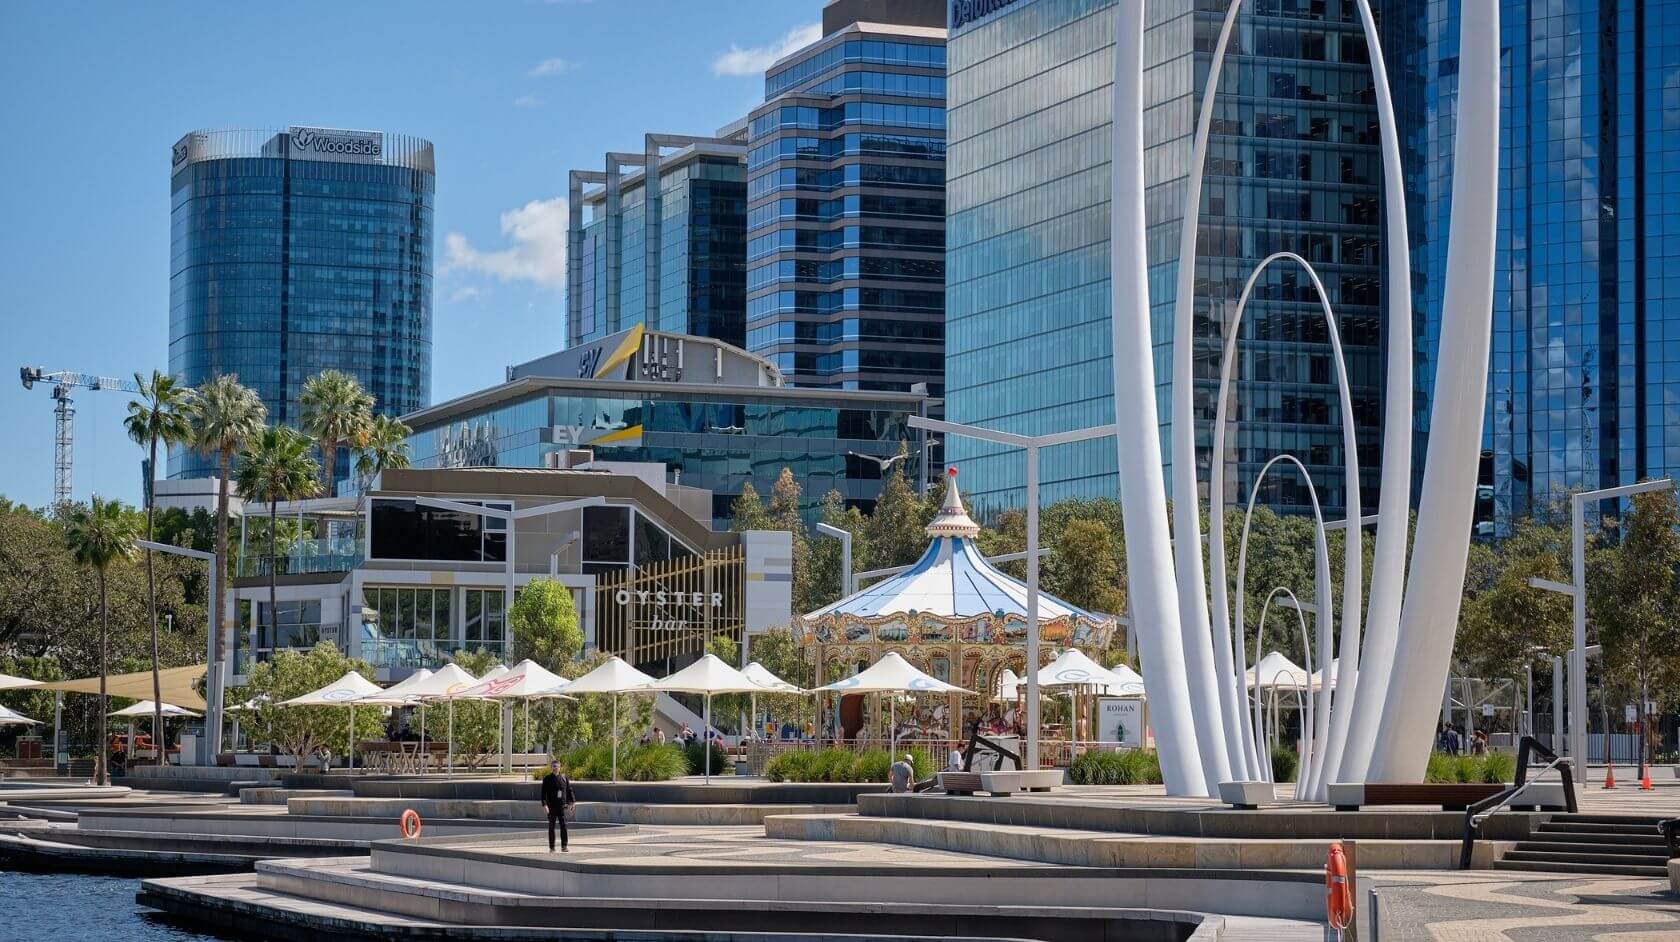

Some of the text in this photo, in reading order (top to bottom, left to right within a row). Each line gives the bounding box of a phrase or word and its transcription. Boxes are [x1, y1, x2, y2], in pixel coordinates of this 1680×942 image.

[313, 137, 380, 155] Woodside
[553, 424, 584, 444] EY
[616, 590, 722, 607] OYSTER
[651, 615, 687, 631] bar
